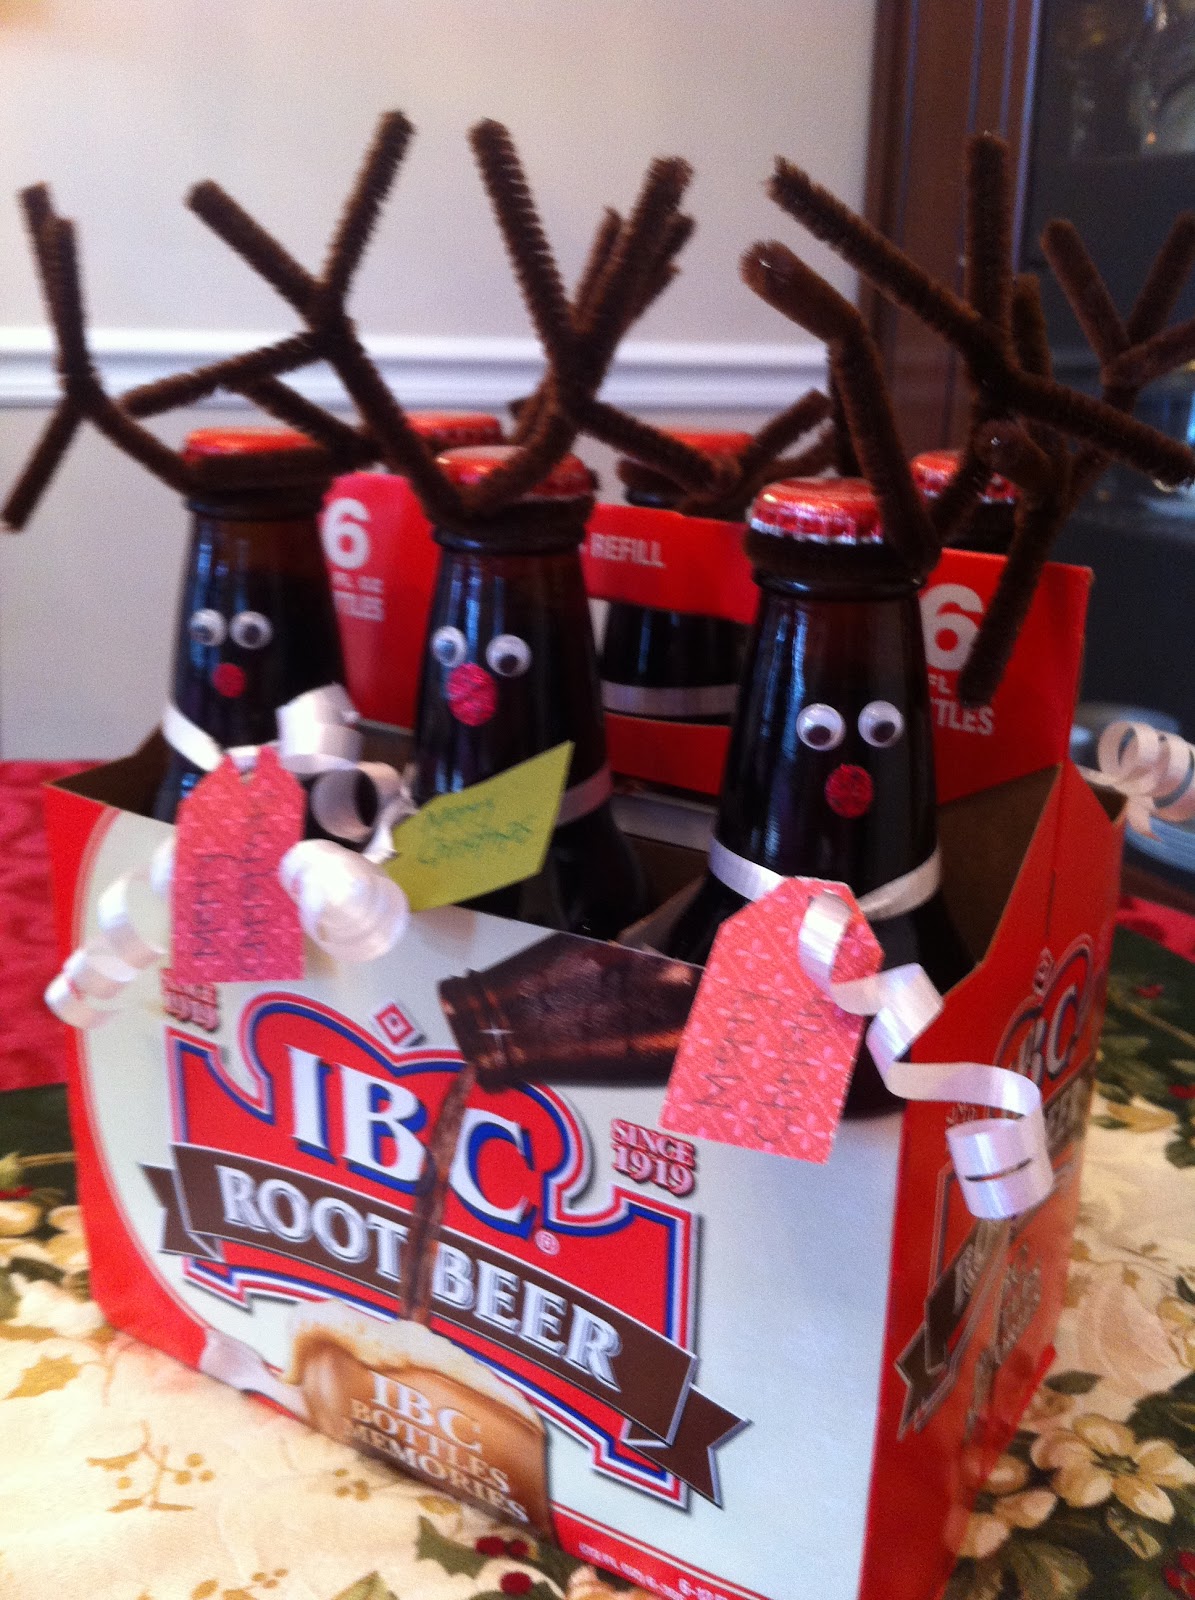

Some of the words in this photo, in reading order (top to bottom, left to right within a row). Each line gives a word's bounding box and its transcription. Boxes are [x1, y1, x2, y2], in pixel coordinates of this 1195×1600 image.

[321, 498, 370, 570] 6
[590, 532, 666, 569] REFILL
[918, 583, 983, 672] 6
[284, 1044, 537, 1240] IBC
[611, 1118, 697, 1169] SINCE
[611, 1143, 696, 1196] 1919
[216, 1163, 409, 1283] ROOT
[431, 1242, 623, 1393] BEER
[351, 1400, 511, 1495] BOTTLES
[369, 1370, 483, 1455] IBC
